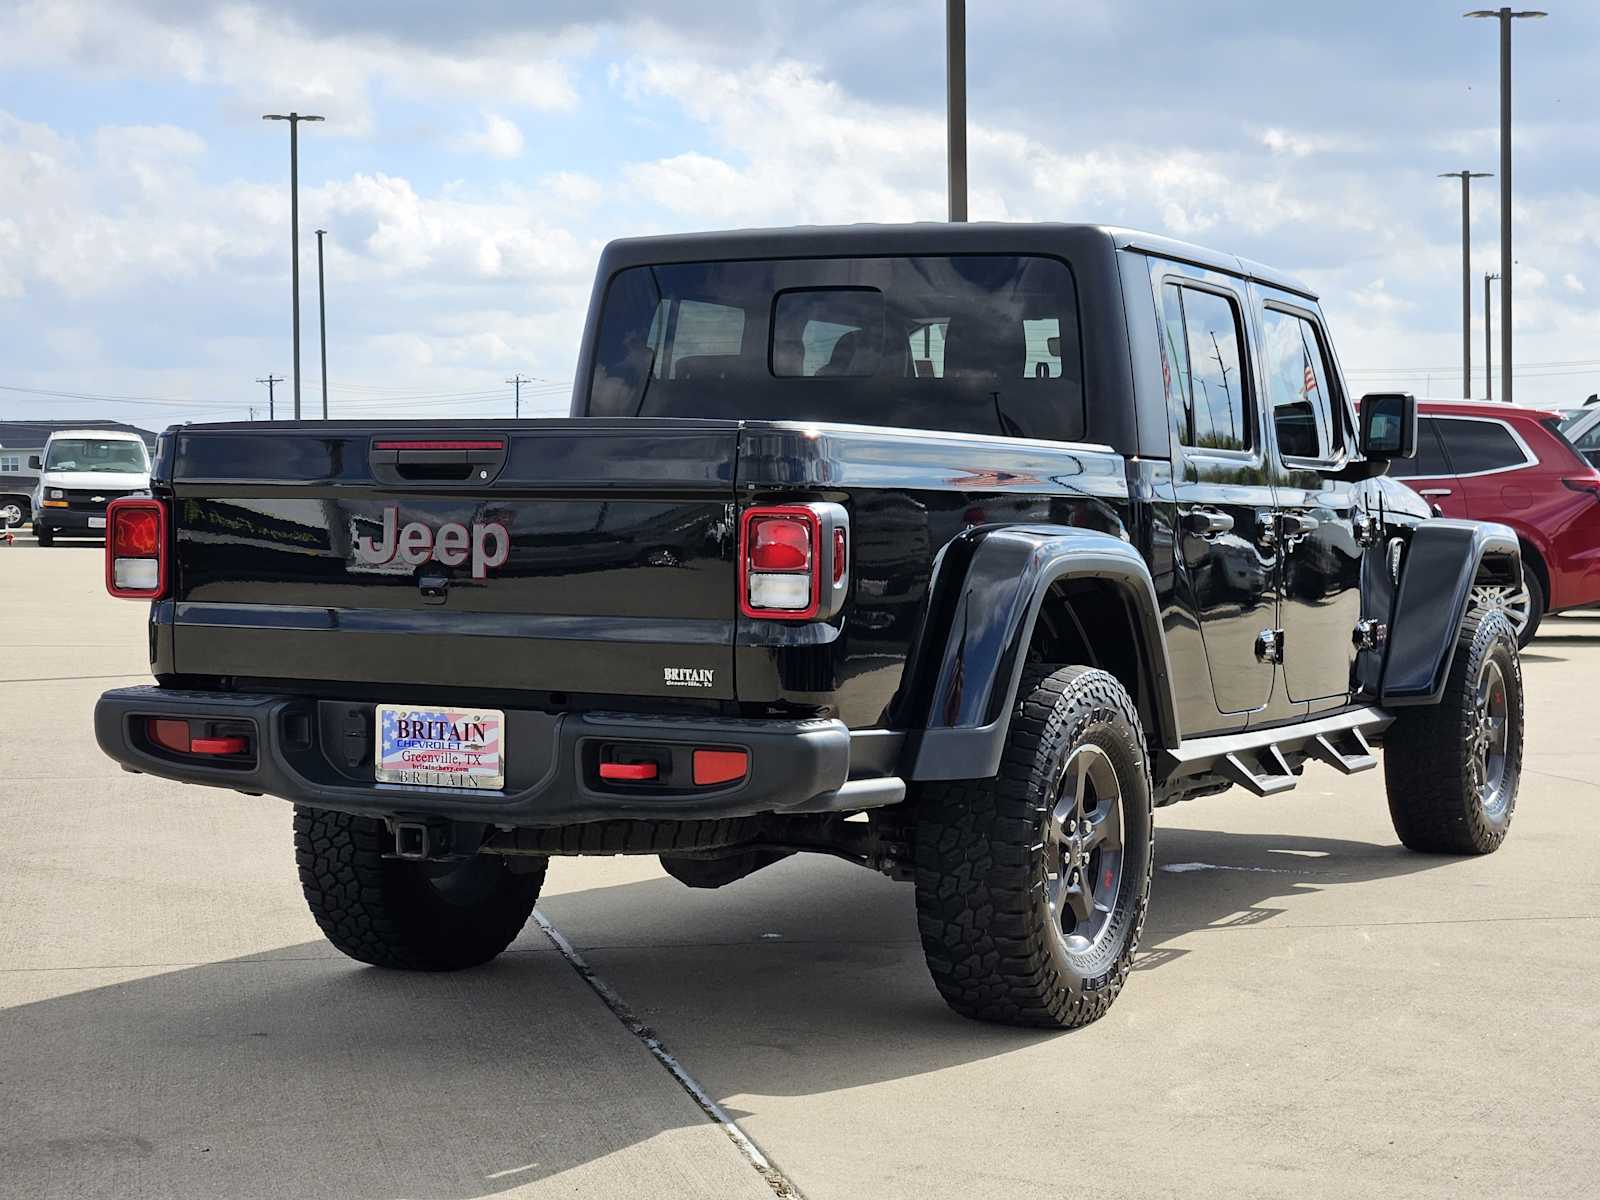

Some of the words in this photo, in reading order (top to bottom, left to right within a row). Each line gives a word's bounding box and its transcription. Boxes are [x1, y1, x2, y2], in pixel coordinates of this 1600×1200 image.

[359, 506, 510, 580] Jeep
[664, 668, 714, 681] BRITAIN
[398, 720, 487, 742] BRITAIN
[397, 740, 461, 750] CHEVROLET
[402, 751, 461, 765] Greenville,
[465, 754, 482, 765] TX
[400, 771, 479, 788] BRITAIN
